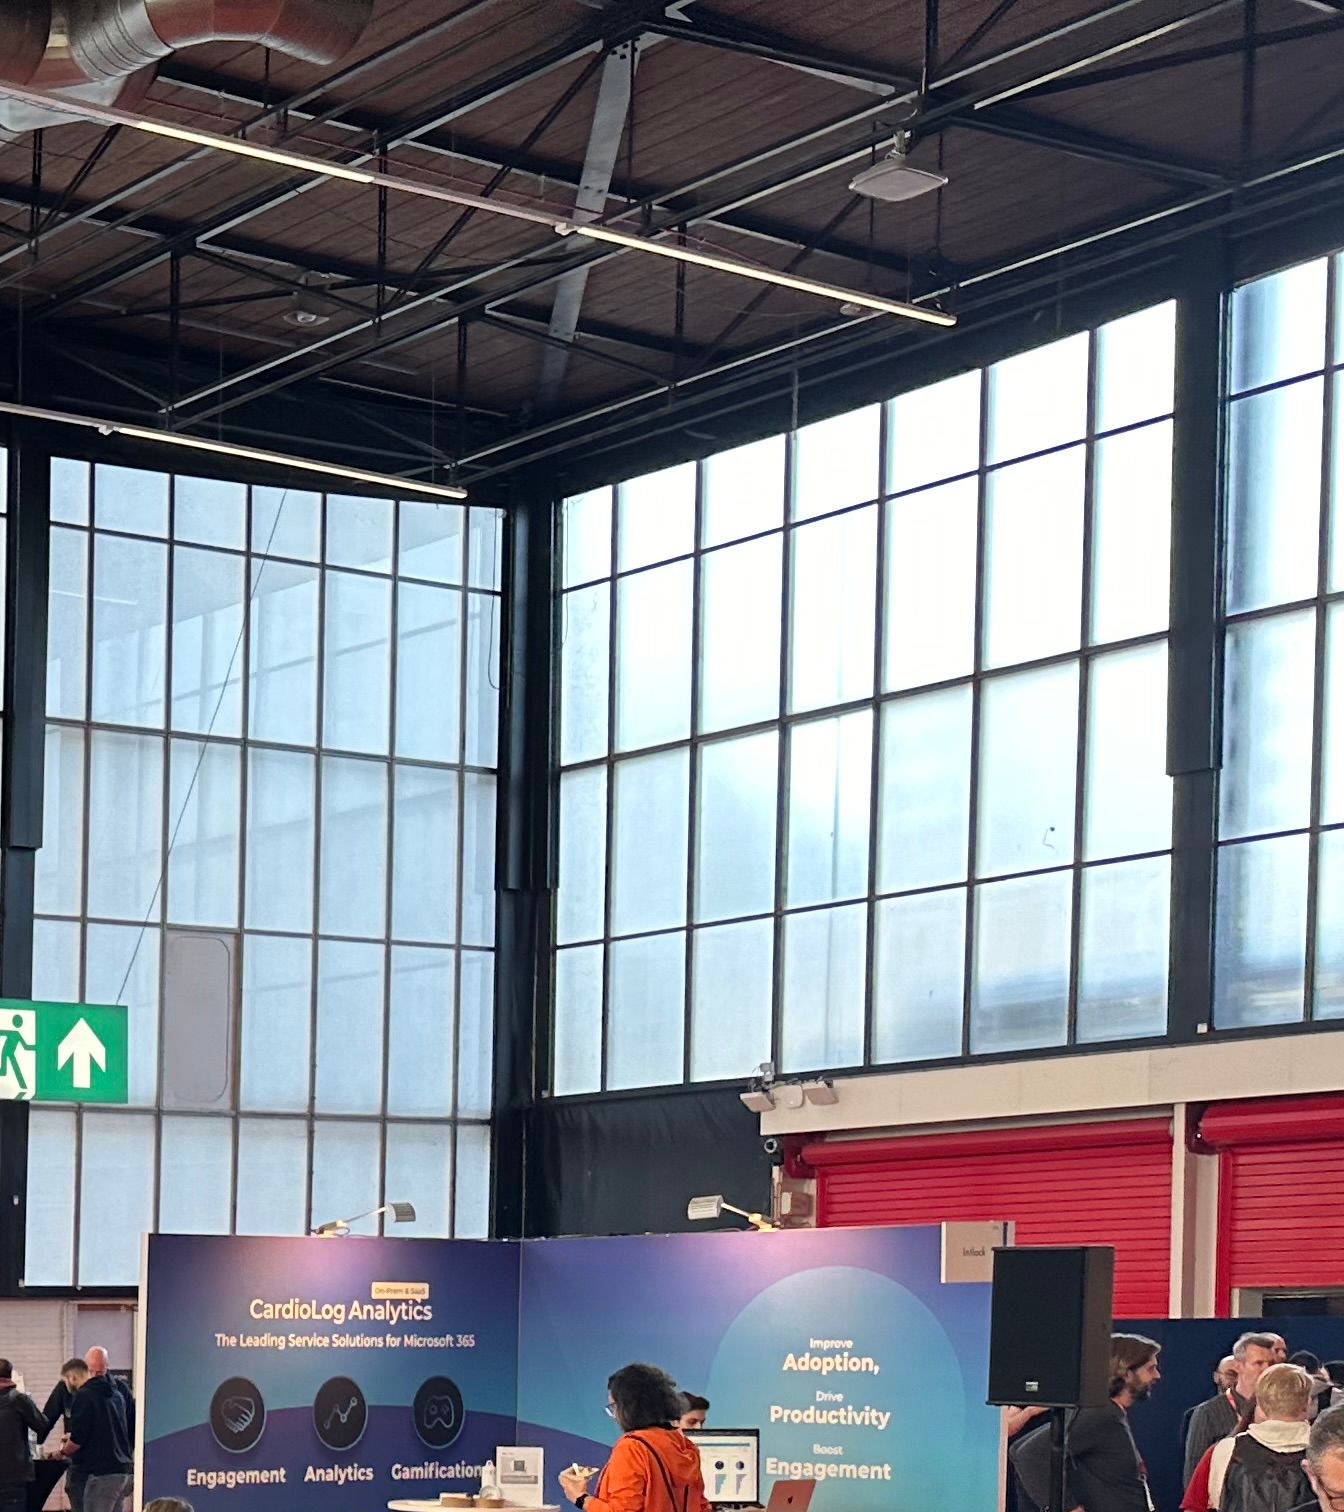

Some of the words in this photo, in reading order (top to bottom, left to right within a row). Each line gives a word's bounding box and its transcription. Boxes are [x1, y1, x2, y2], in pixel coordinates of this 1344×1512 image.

[250, 1298, 346, 1324] CardioLog
[348, 1299, 433, 1325] Analytics
[215, 1334, 237, 1347] The
[240, 1334, 285, 1350] Leading
[288, 1334, 329, 1348] Service
[331, 1334, 384, 1348] Solutions
[386, 1334, 402, 1348] for
[404, 1334, 453, 1348] Microsoft
[456, 1335, 475, 1348] 365
[809, 1337, 853, 1352] Improve
[783, 1352, 880, 1375] Adoption,
[816, 1390, 843, 1402] Drive
[770, 1405, 891, 1430] Productivity
[813, 1444, 843, 1456] Boost
[186, 1467, 286, 1488] Engagement
[304, 1464, 374, 1483] Analytics
[391, 1461, 482, 1480] Gamification
[765, 1457, 892, 1482] Engagement
